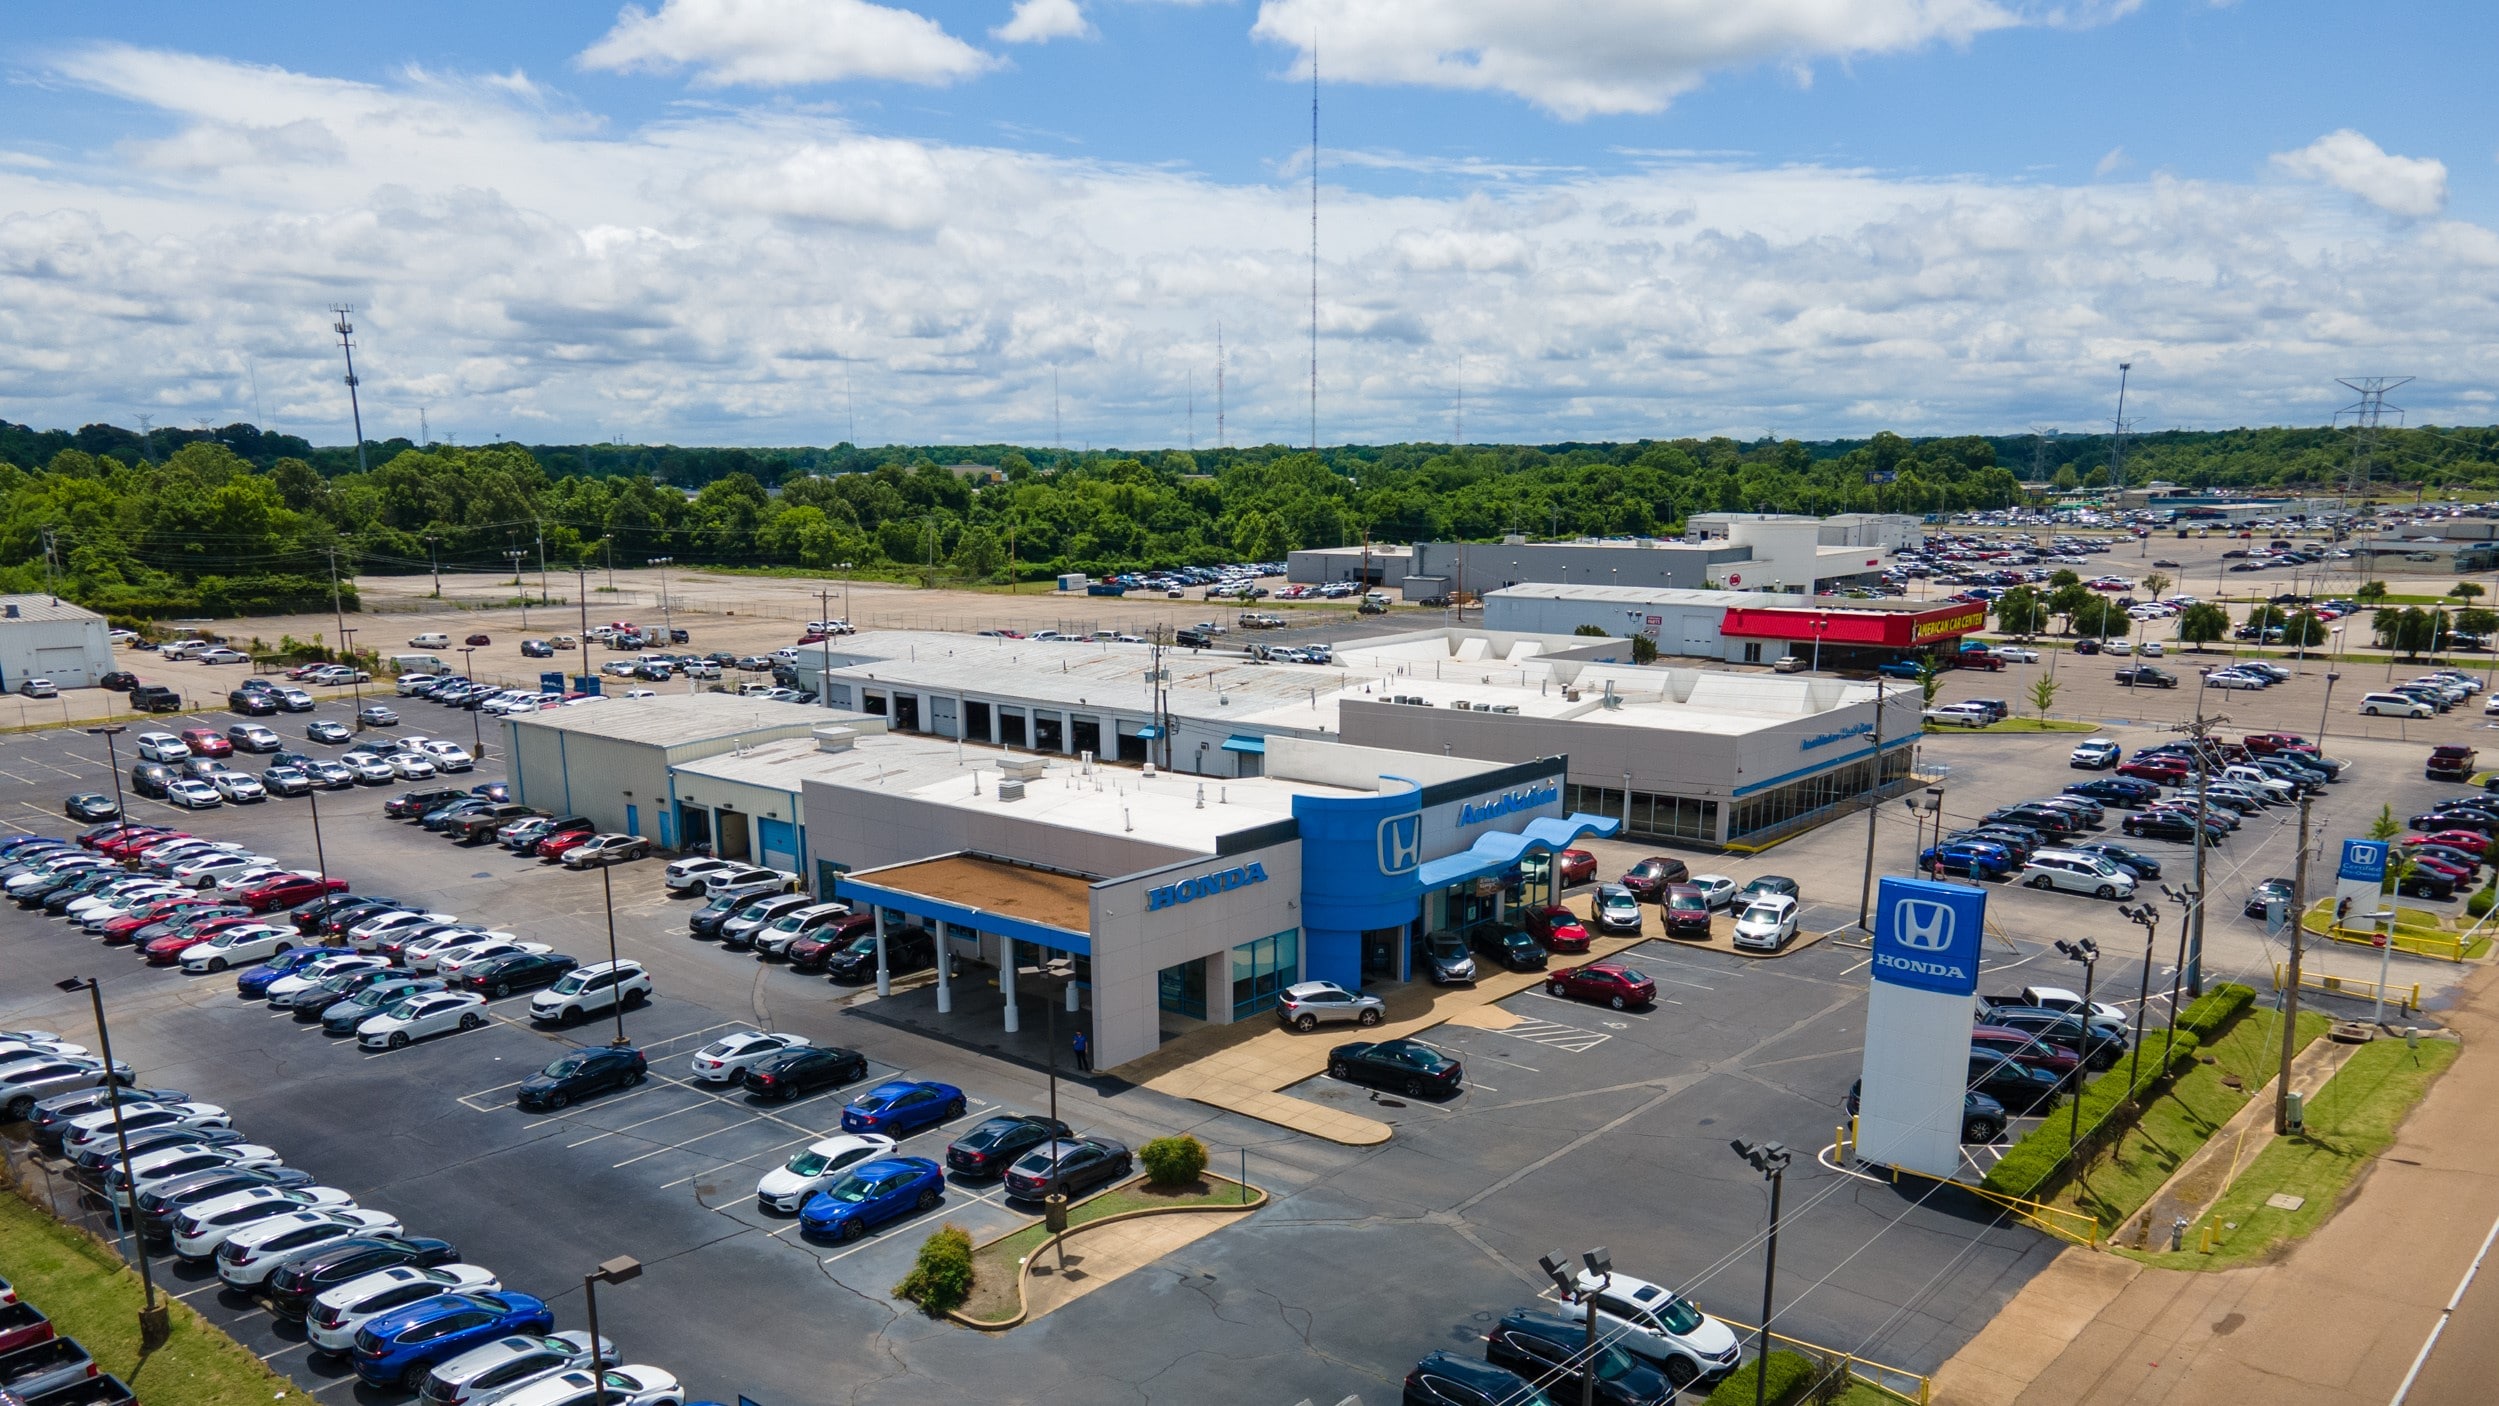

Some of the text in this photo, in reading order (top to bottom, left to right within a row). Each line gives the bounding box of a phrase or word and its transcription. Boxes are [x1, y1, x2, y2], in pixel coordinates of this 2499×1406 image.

[1918, 612, 1983, 637] AMERICAN CAR CENTER
[1456, 785, 1558, 827] AutoNation
[2342, 862, 2382, 872] Certified
[1145, 860, 1268, 912] HONDA
[1877, 953, 1967, 979] HONDA
